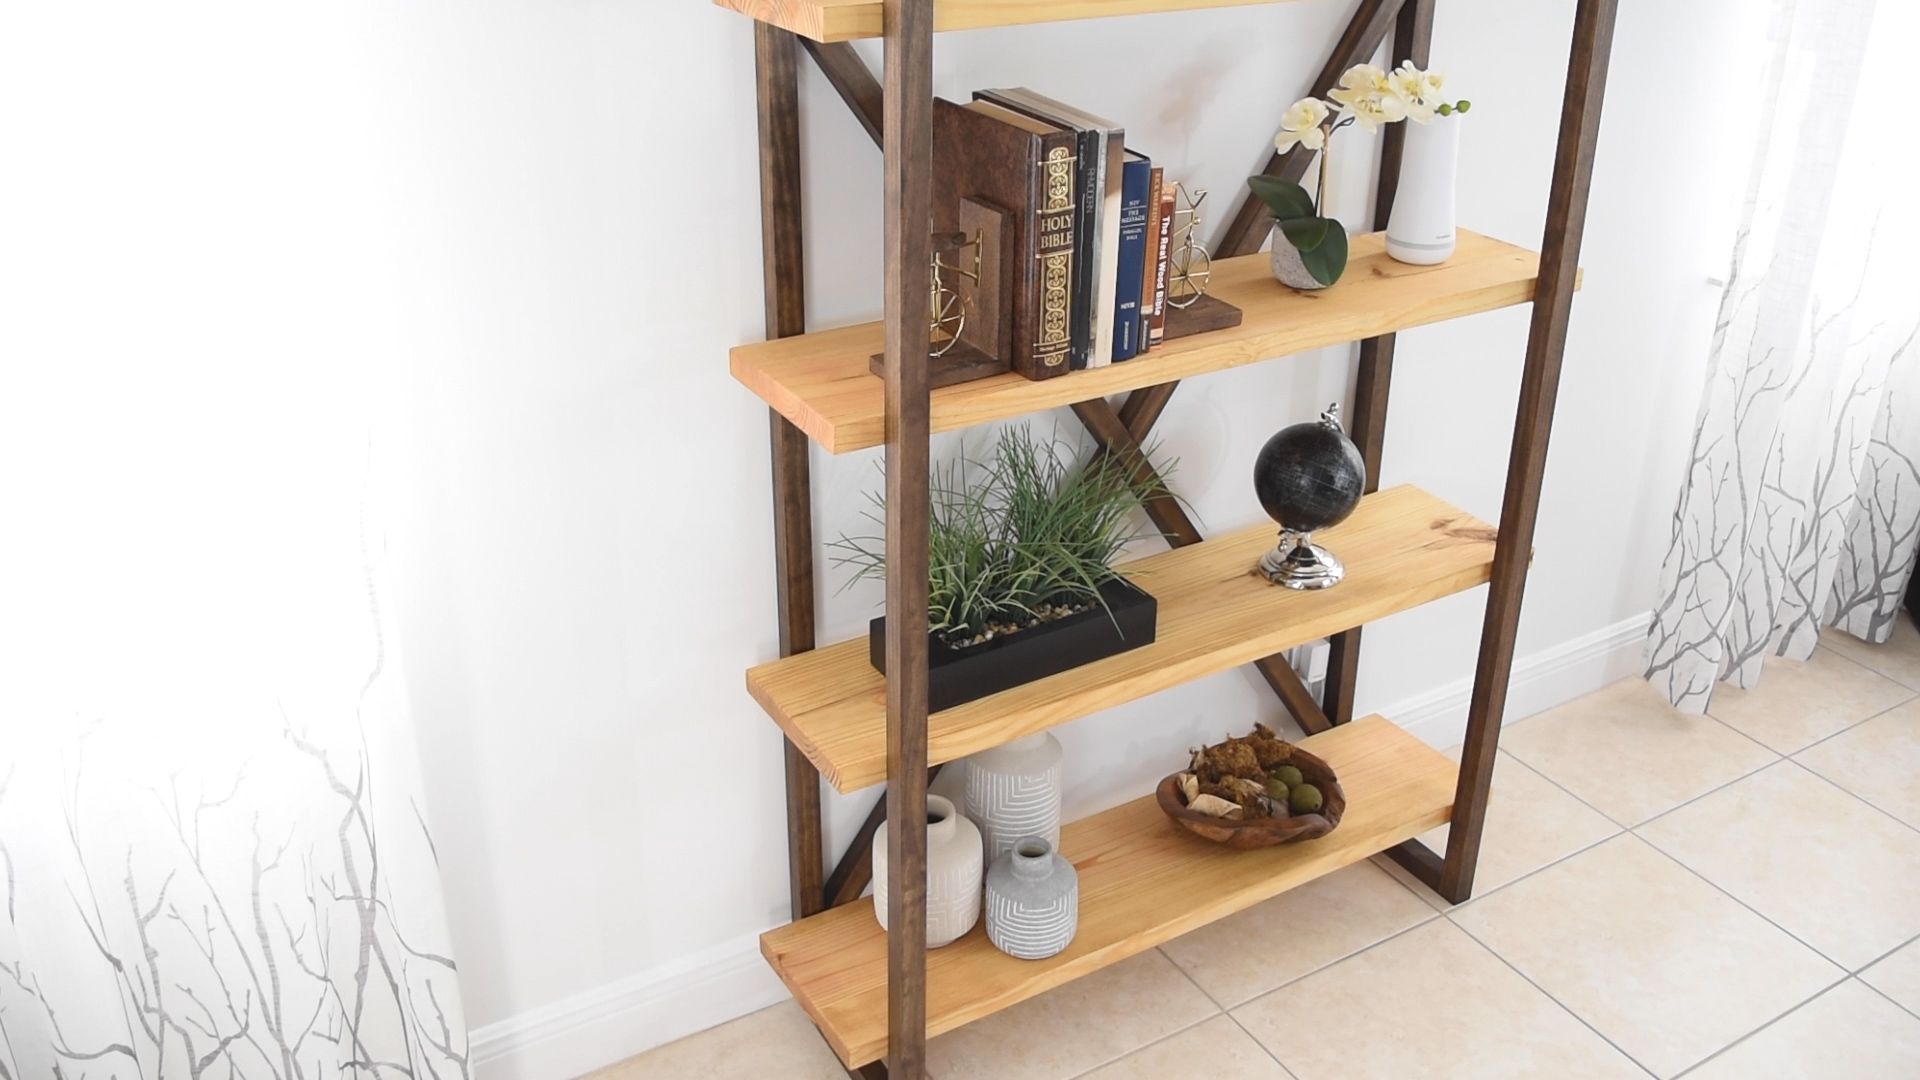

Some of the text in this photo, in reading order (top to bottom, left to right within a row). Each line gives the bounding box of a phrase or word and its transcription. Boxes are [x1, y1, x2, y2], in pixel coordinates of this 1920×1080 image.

[1041, 214, 1073, 232] HOLY
[1041, 231, 1073, 248] BIBLE
[1154, 215, 1171, 316] The Real Wood Bible
